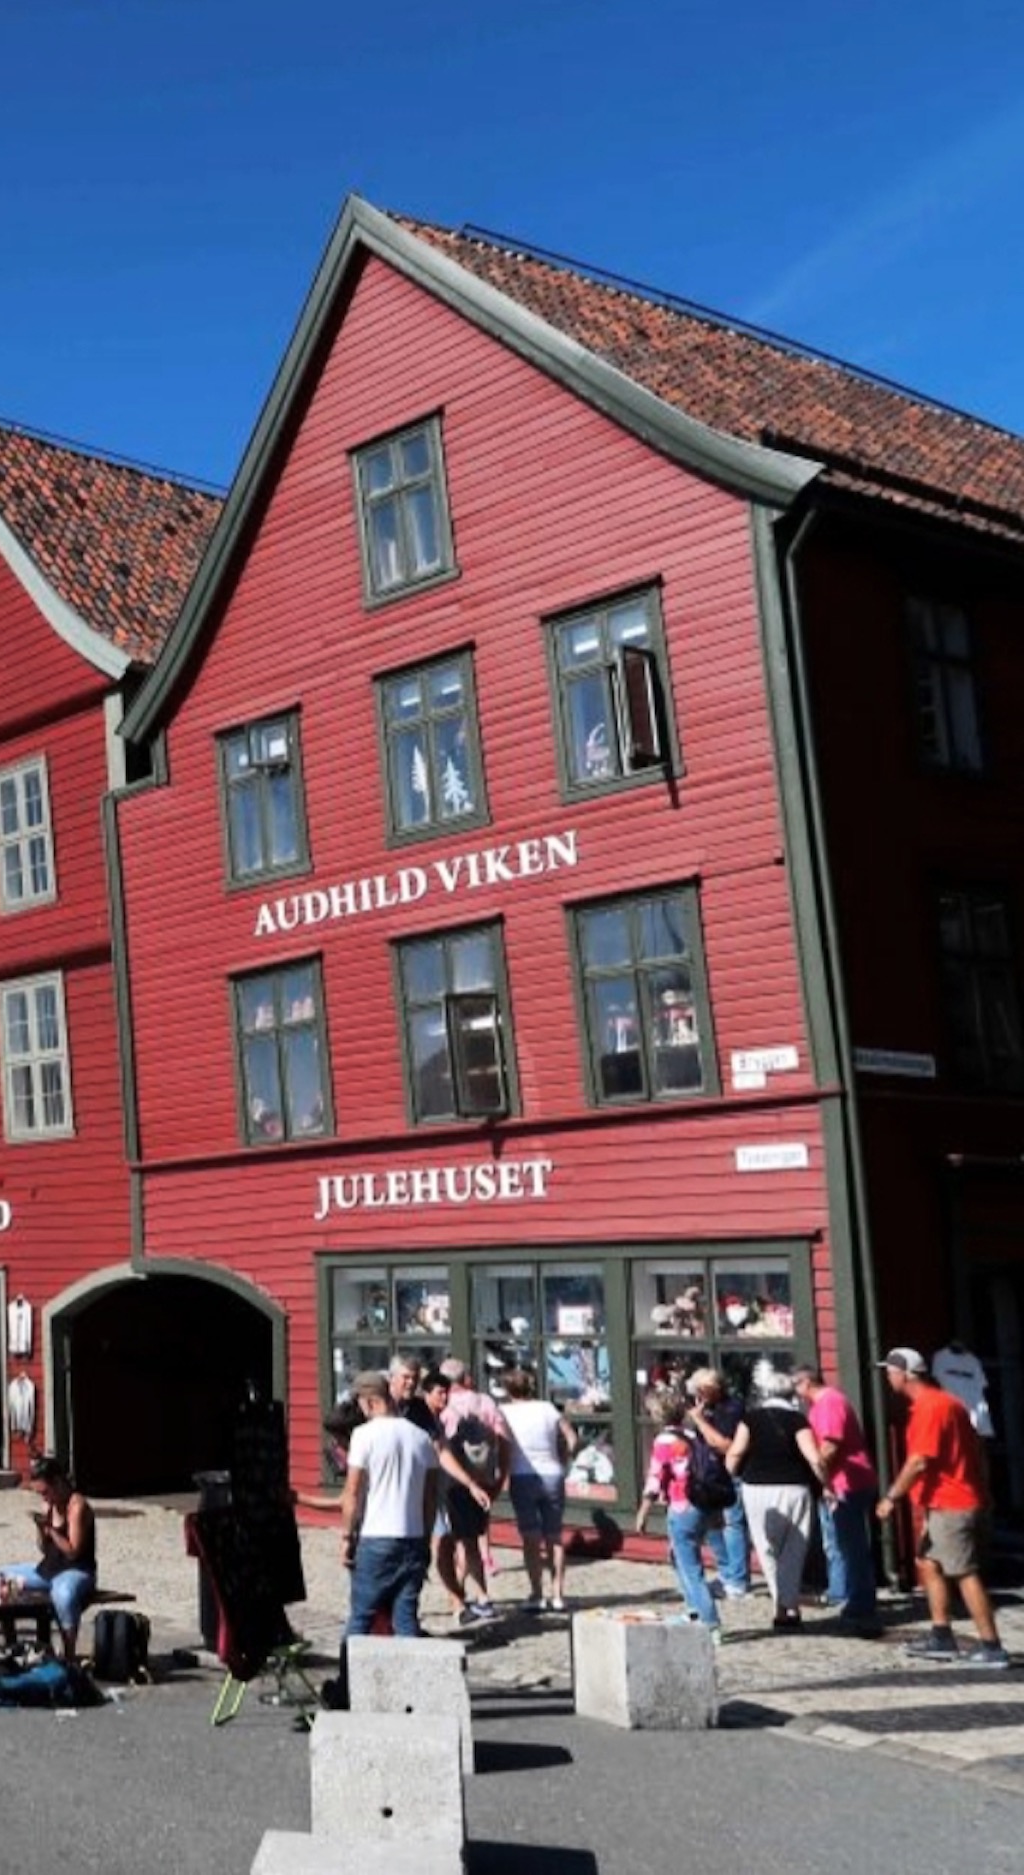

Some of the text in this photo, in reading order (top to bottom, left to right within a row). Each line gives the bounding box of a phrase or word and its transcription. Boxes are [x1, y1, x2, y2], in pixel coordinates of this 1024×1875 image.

[254, 830, 578, 937] AUDHILD VIKEN
[314, 1158, 553, 1221] JULEHUSET
